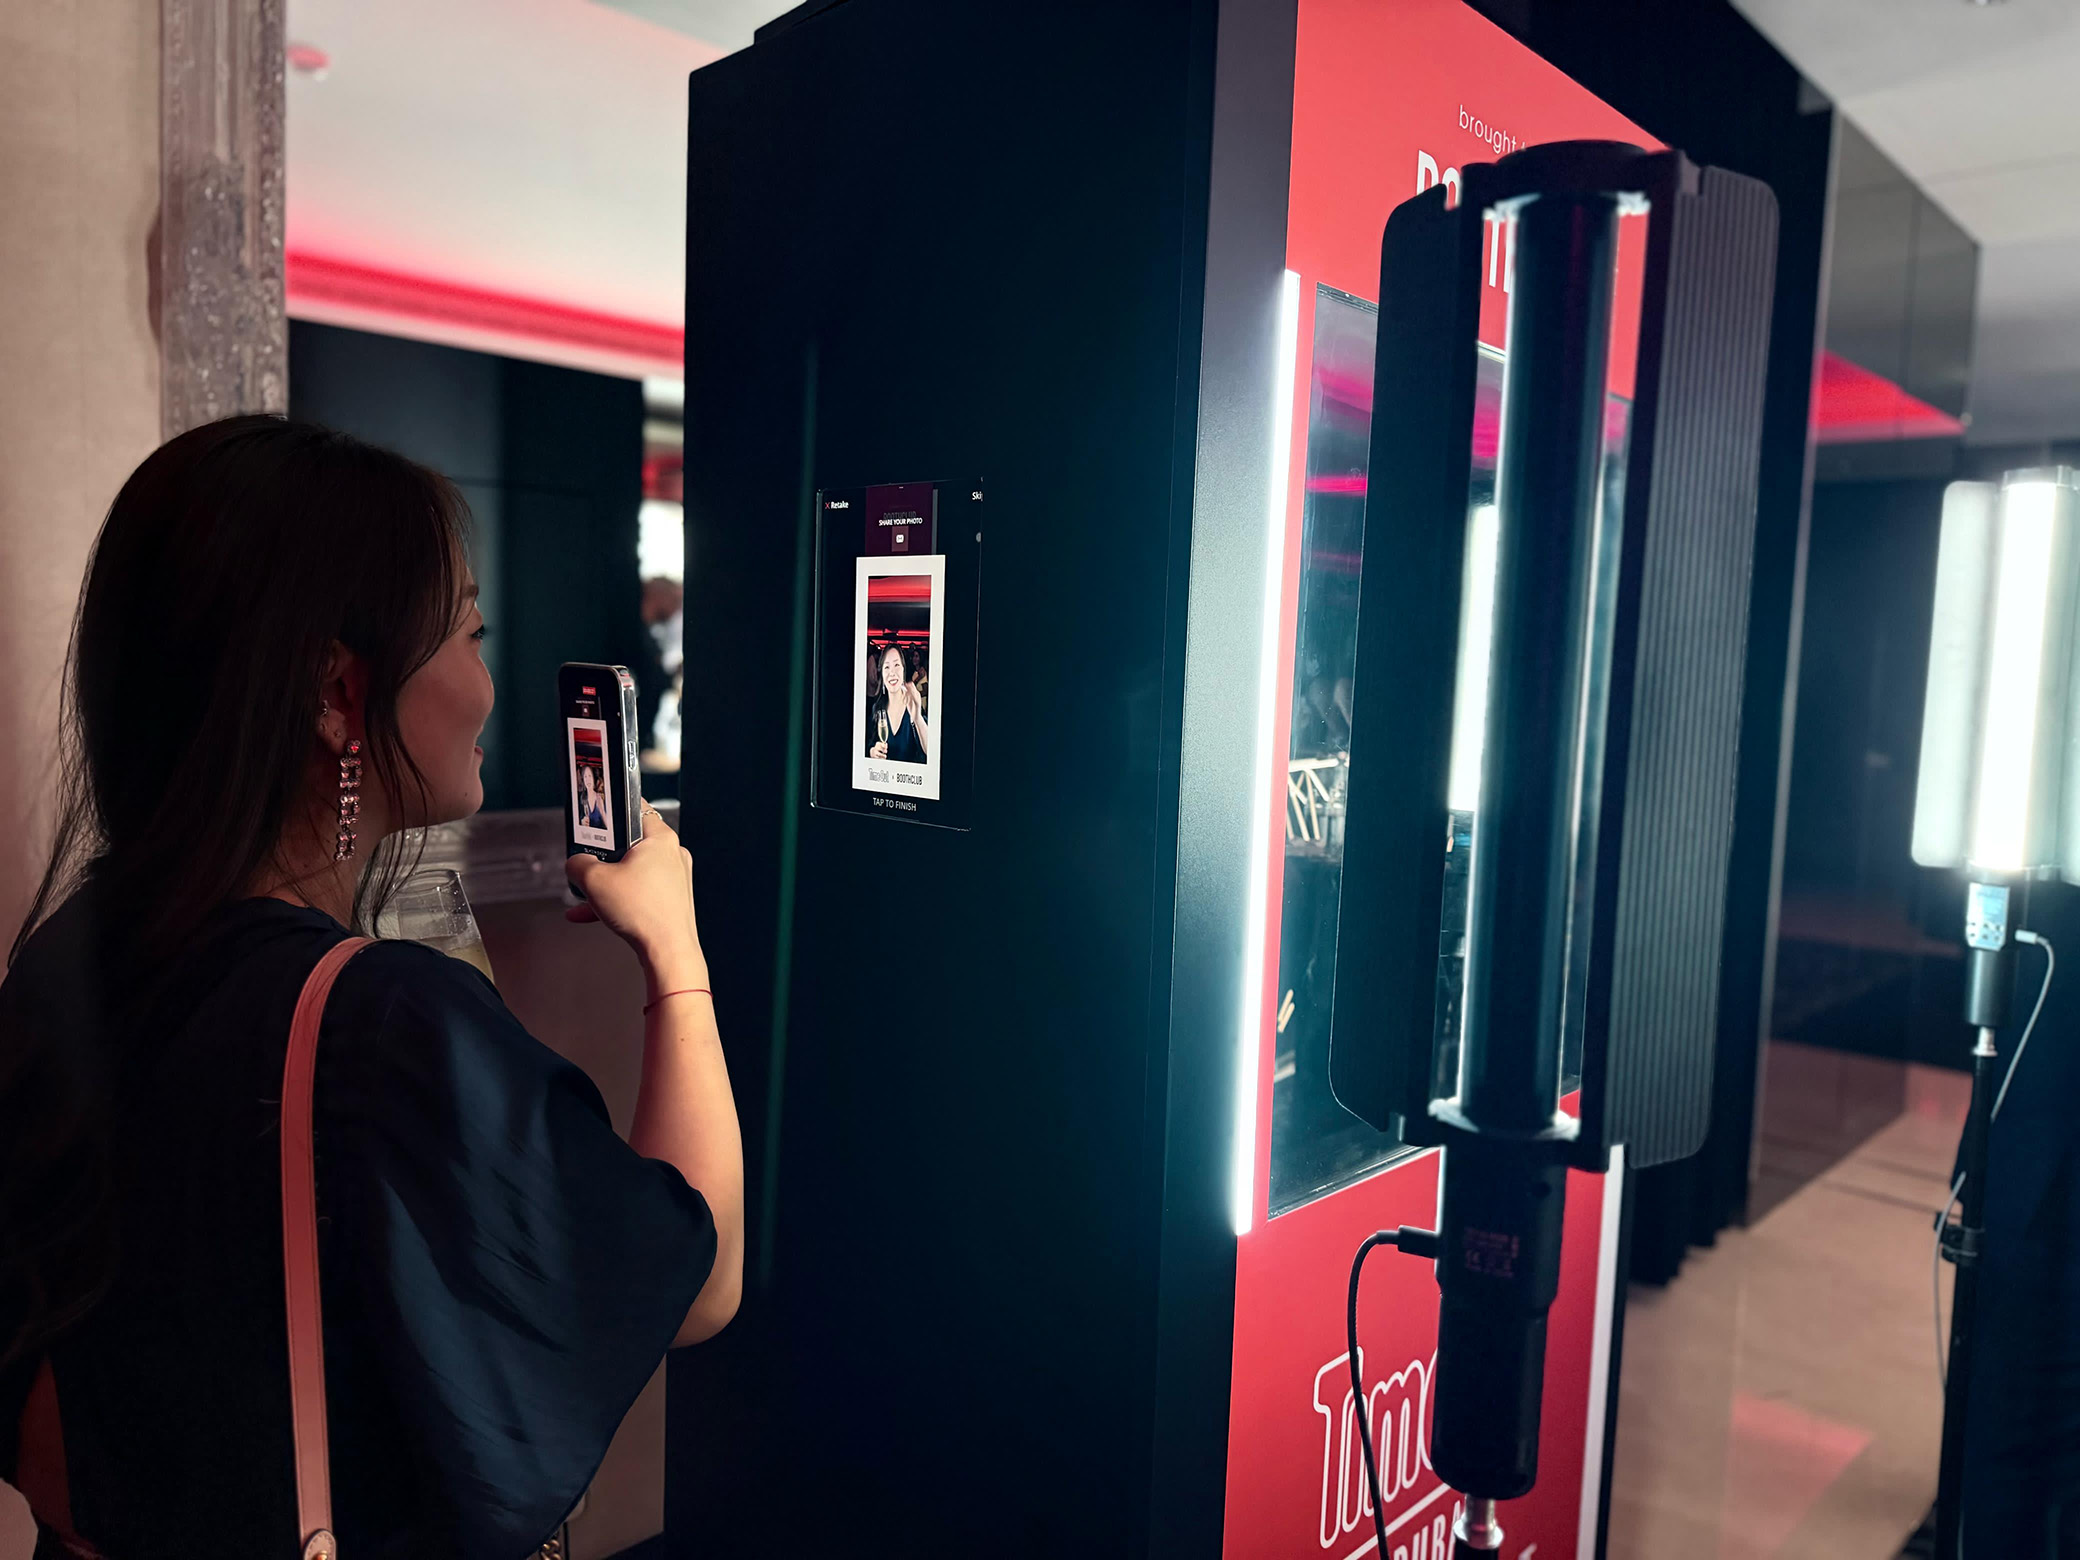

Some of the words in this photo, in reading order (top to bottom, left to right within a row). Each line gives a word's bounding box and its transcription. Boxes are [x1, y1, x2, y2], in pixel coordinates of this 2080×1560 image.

[1458, 104, 1517, 154] brought
[831, 501, 849, 509] Retake
[906, 517, 923, 525] PHOTO
[896, 773, 922, 785] BOOTHCLUB
[873, 797, 884, 806] TAP
[885, 799, 894, 808] TO
[895, 801, 917, 811] FINISH
